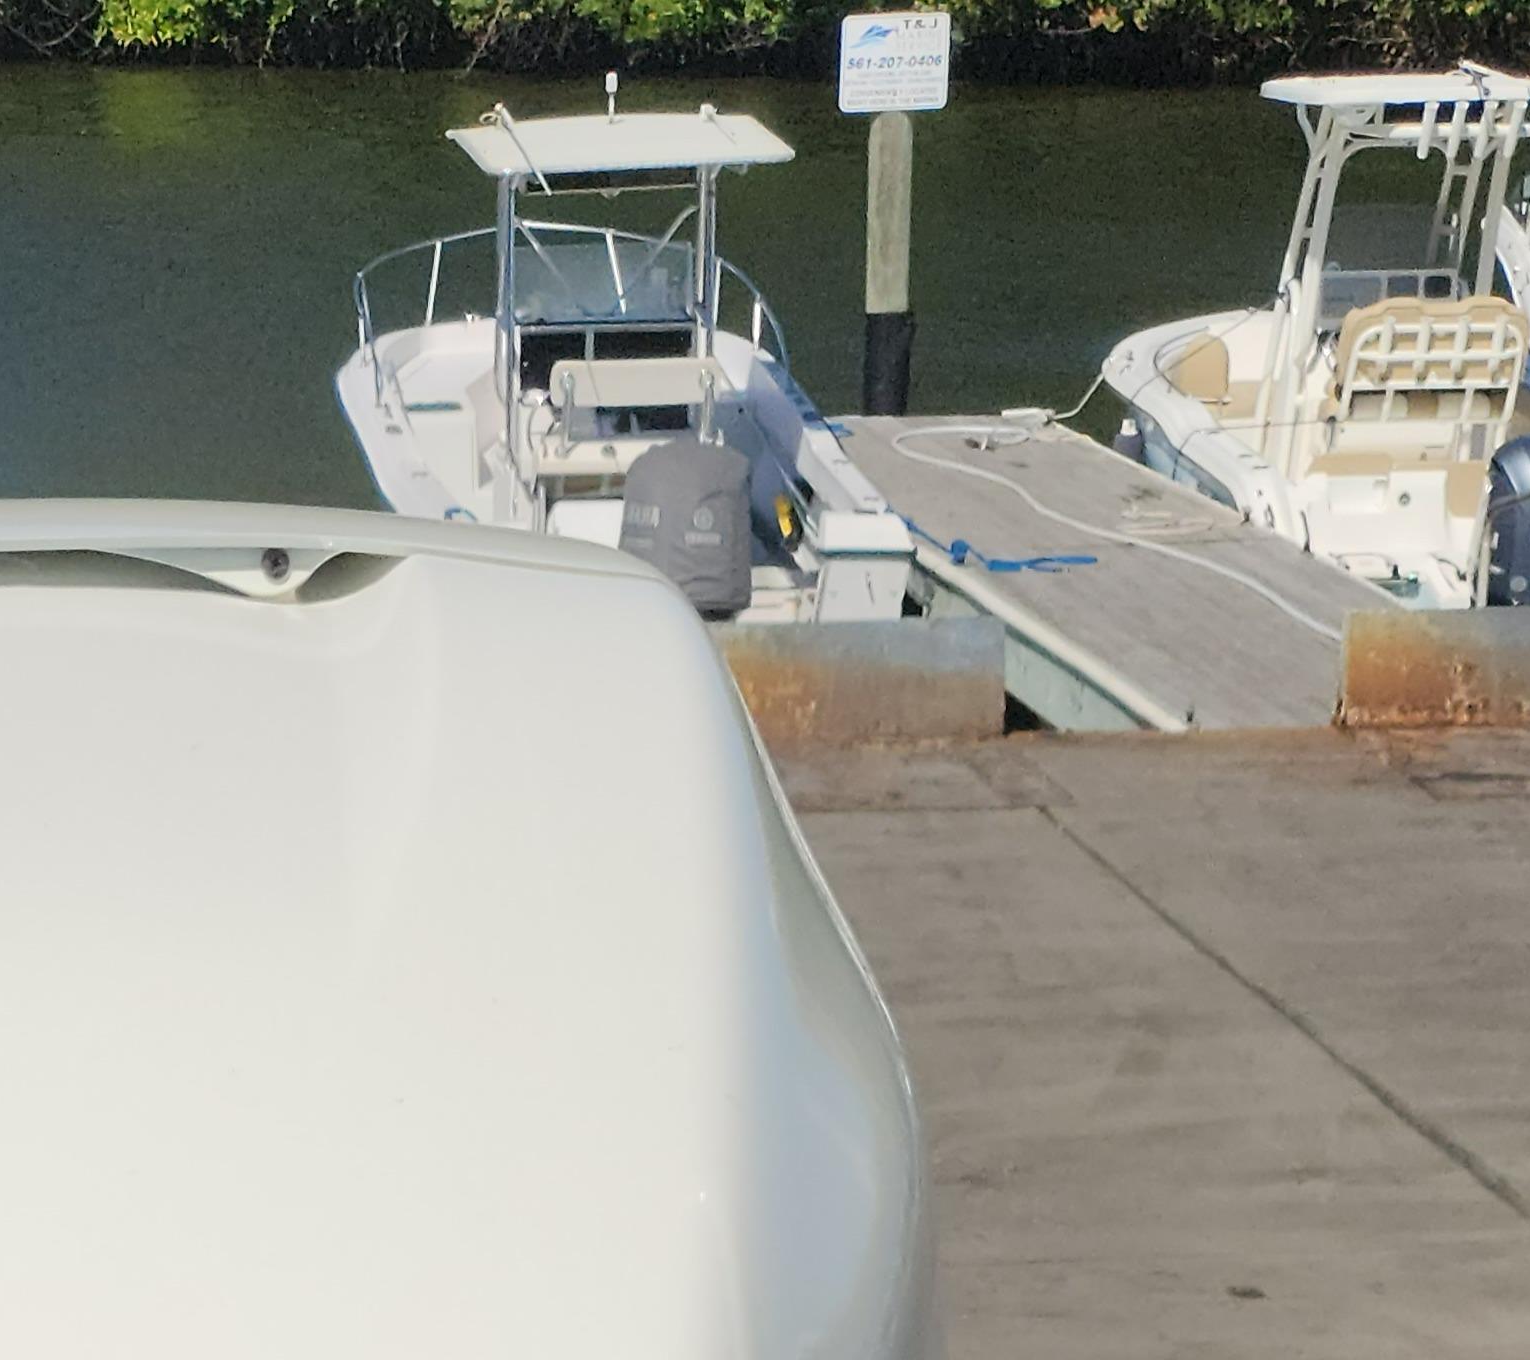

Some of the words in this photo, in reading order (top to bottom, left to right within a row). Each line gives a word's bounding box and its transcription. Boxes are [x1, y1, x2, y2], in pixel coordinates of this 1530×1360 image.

[903, 19, 912, 30] T
[914, 18, 926, 30] &
[929, 17, 938, 29] J
[846, 54, 943, 70] 561-207-0406
